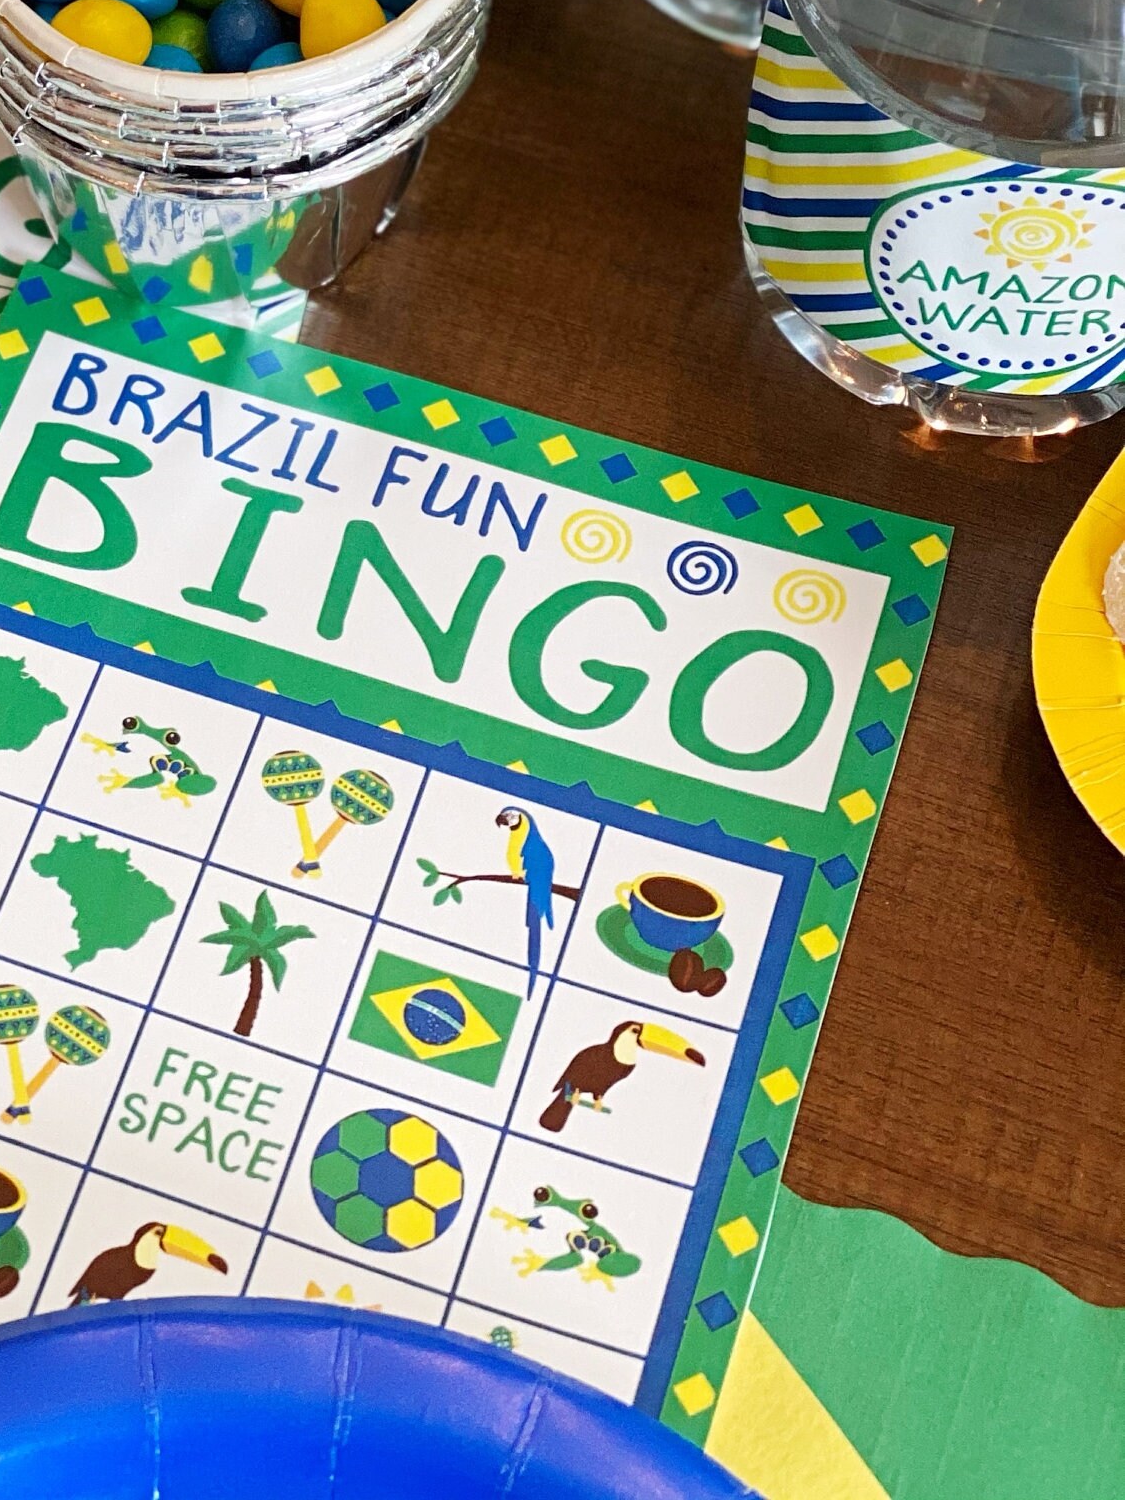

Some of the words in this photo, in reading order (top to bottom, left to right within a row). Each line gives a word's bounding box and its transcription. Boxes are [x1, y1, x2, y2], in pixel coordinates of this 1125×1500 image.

[918, 297, 1113, 337] WATER
[51, 352, 342, 496] BRAZIL
[372, 444, 549, 553] FUN
[153, 1046, 283, 1125] FREE
[118, 1092, 286, 1182] SPACE
